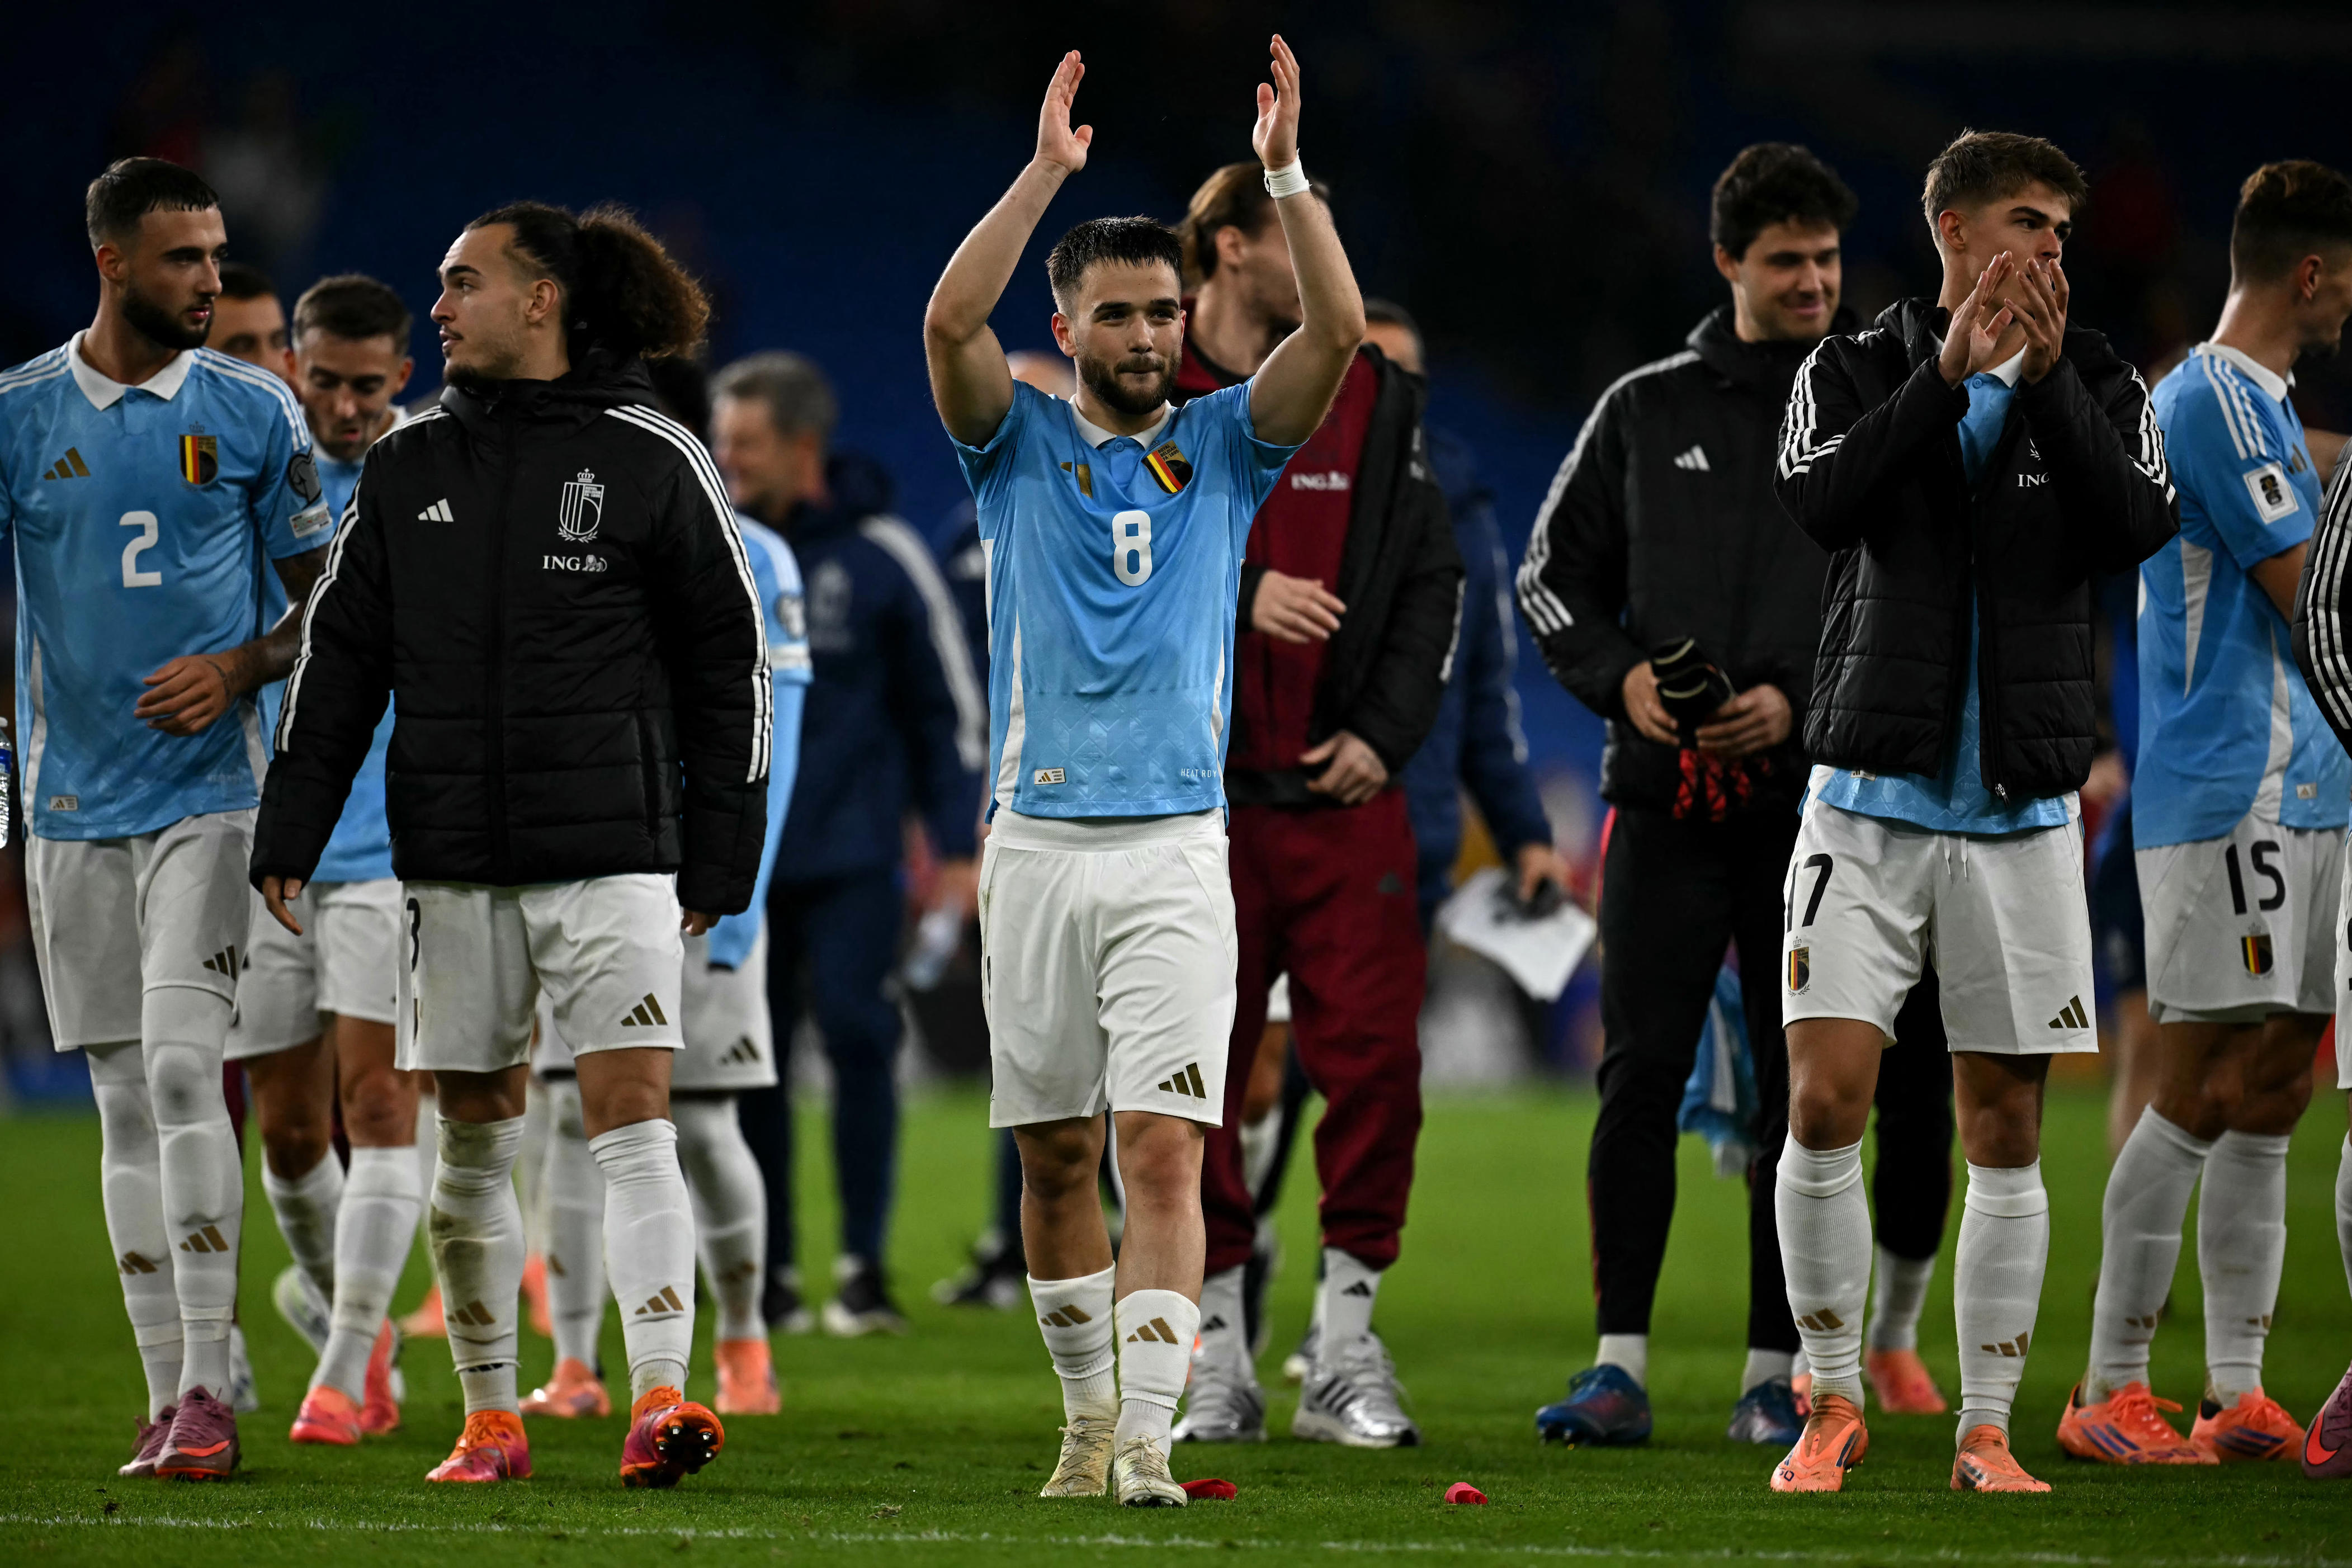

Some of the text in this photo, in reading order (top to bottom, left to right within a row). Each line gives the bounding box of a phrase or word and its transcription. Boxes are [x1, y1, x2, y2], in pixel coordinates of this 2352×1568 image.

[1158, 444, 1170, 454] ROYAL
[1291, 473, 1327, 490] ING
[119, 511, 162, 588] 2
[542, 555, 580, 571] ING
[1112, 510, 1152, 587] 8
[1787, 853, 1833, 933] 17
[2226, 840, 2285, 915] 15
